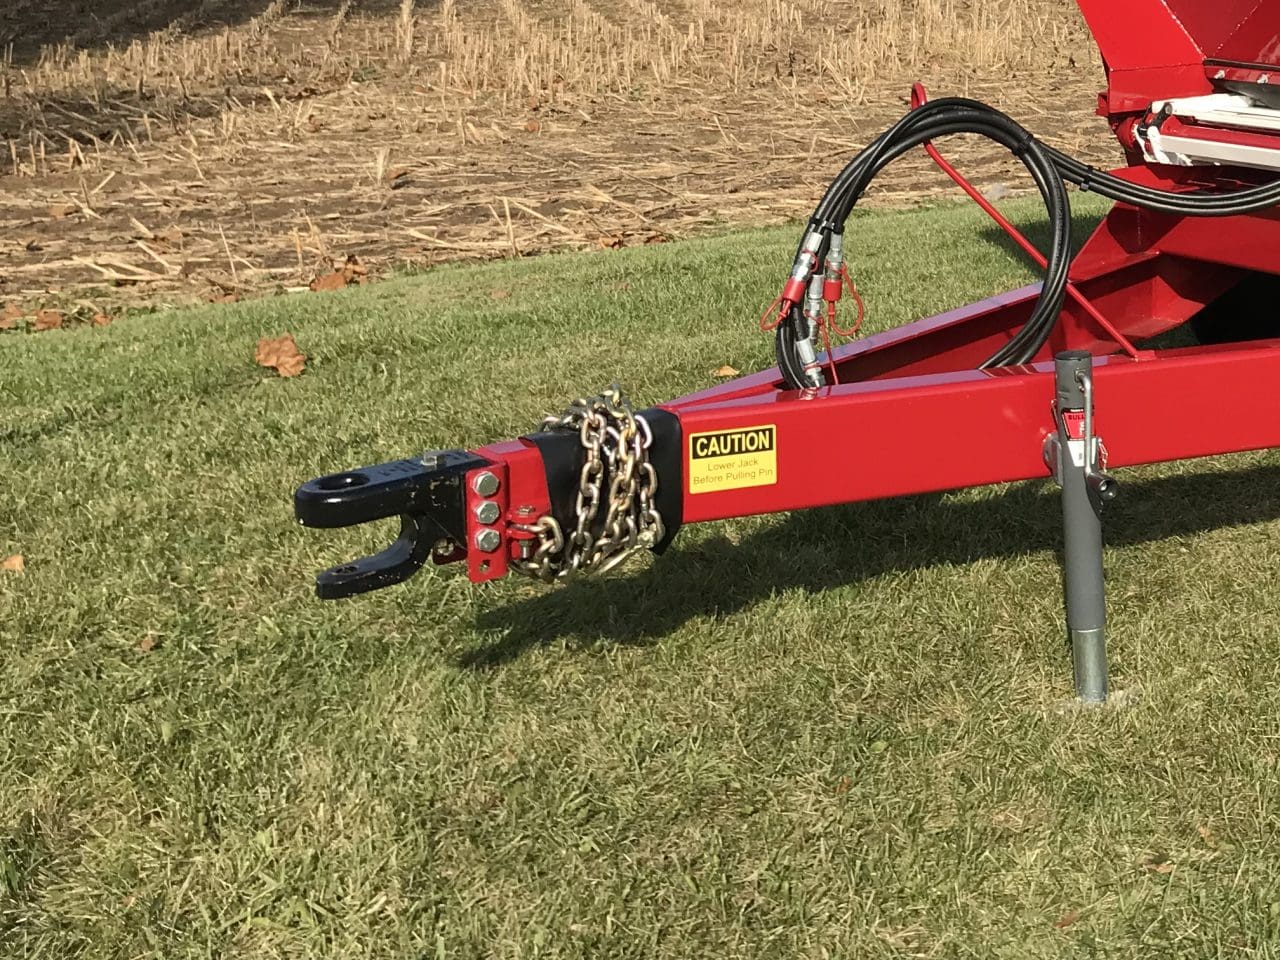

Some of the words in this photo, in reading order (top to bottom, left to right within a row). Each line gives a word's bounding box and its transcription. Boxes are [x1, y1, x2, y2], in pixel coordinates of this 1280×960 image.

[696, 430, 770, 457] CAUTION
[707, 461, 735, 471] Lower
[738, 458, 759, 468] Jack
[693, 475, 723, 485] Before
[725, 470, 756, 481] Pulling
[758, 468, 773, 477] Pin
